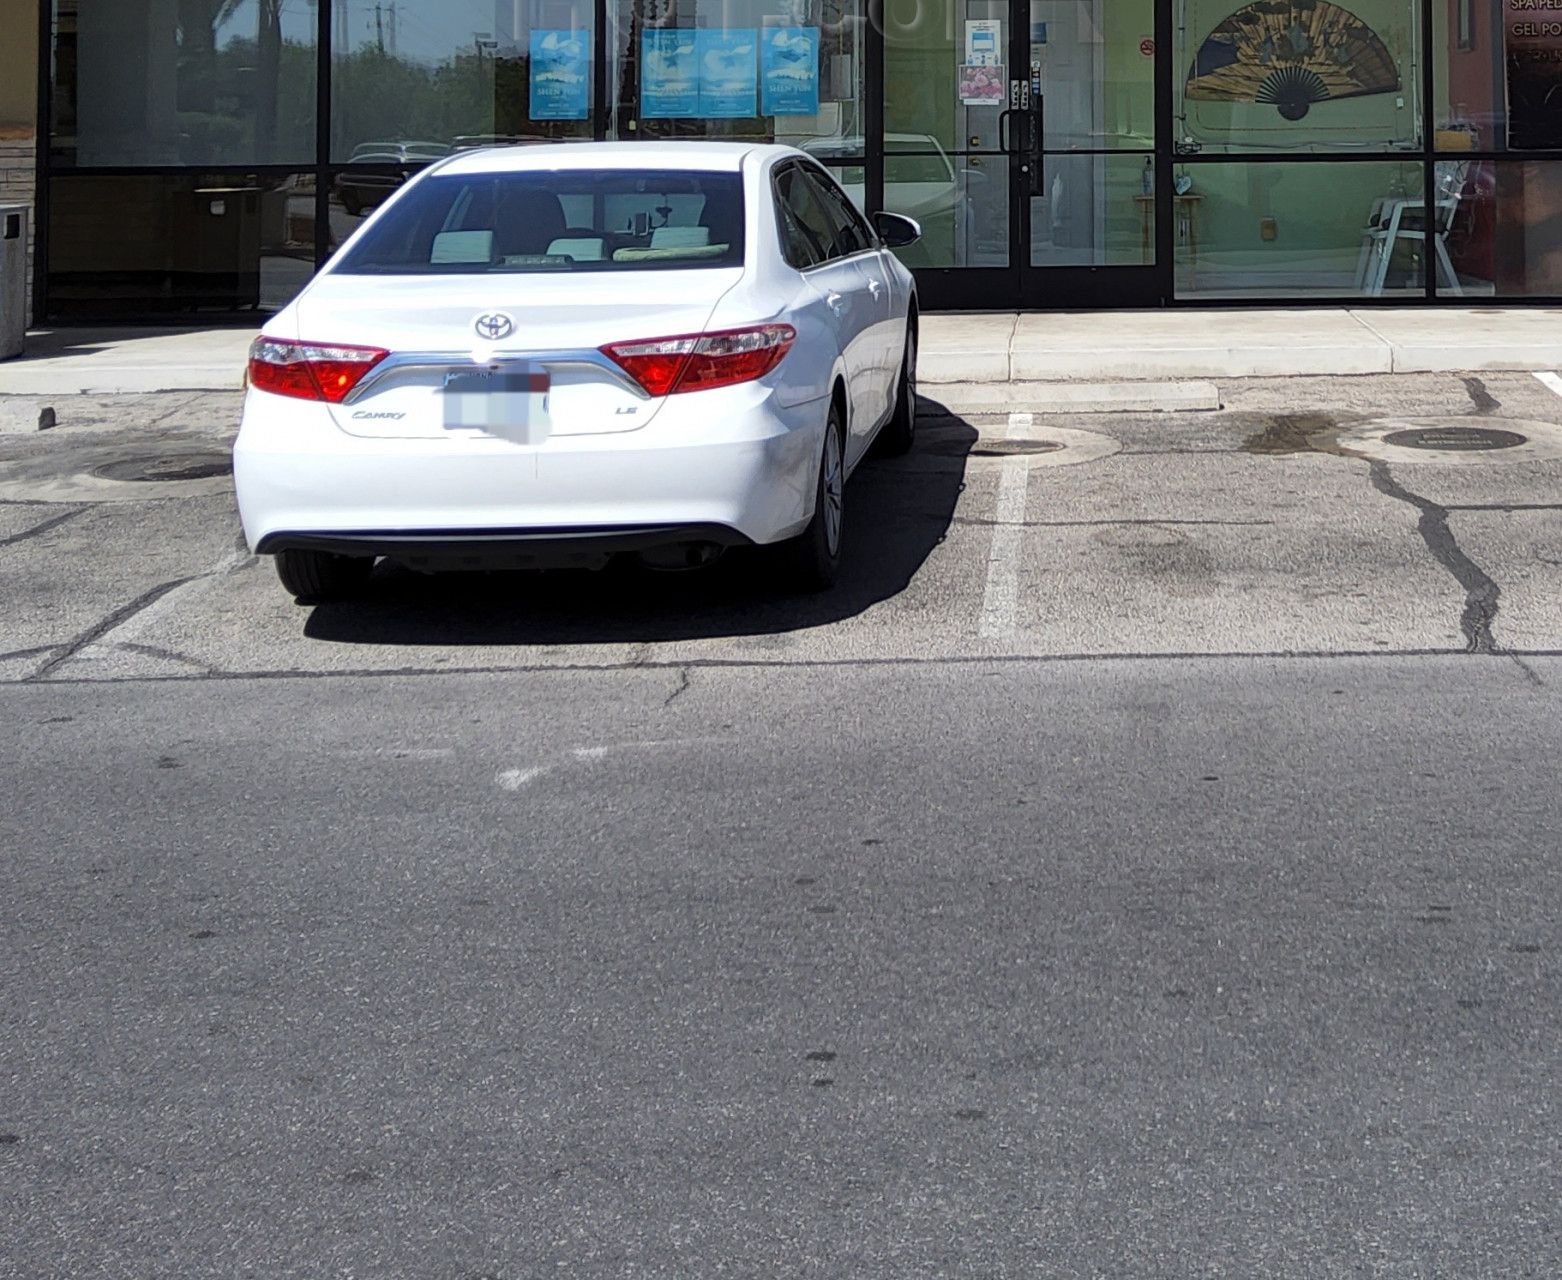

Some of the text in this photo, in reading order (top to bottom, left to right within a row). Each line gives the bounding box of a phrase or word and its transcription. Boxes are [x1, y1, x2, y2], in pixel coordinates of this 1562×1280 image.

[1512, 22, 1562, 36] GEL PO
[615, 407, 638, 415] LE
